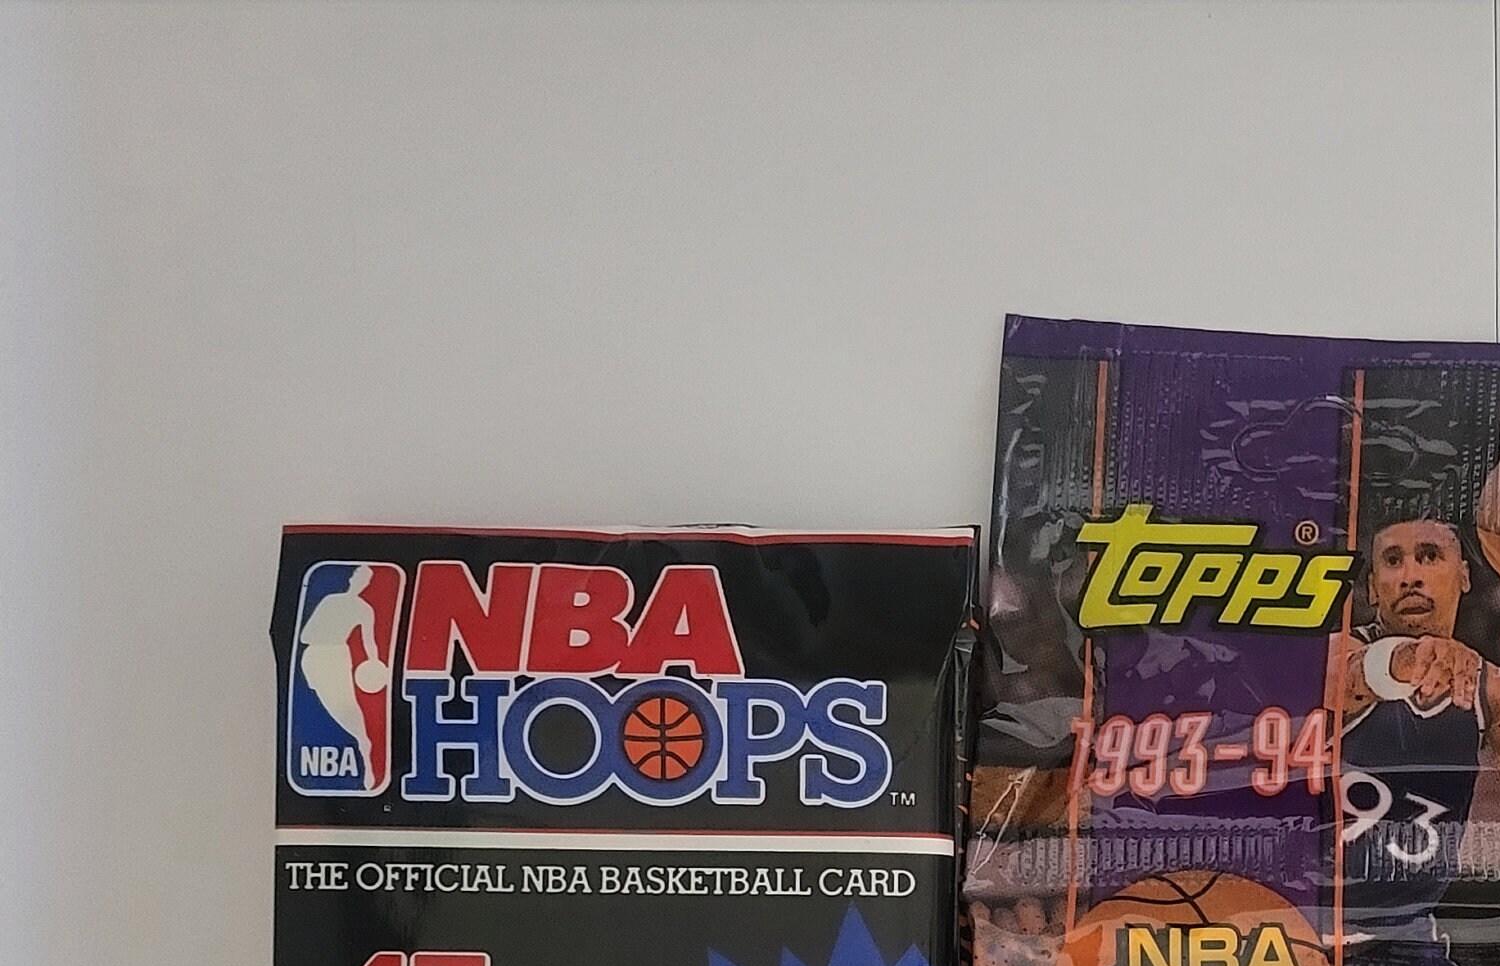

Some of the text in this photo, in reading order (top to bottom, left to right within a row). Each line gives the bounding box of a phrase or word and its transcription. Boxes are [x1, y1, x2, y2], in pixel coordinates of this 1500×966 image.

[405, 560, 743, 676] NBA
[301, 745, 358, 777] NBA
[403, 677, 893, 807] HOOPS
[1066, 706, 1333, 798] 1993-94
[1340, 771, 1449, 864] 93
[285, 862, 916, 898] THE OFFICIAL NBA BASKETBALL CARD
